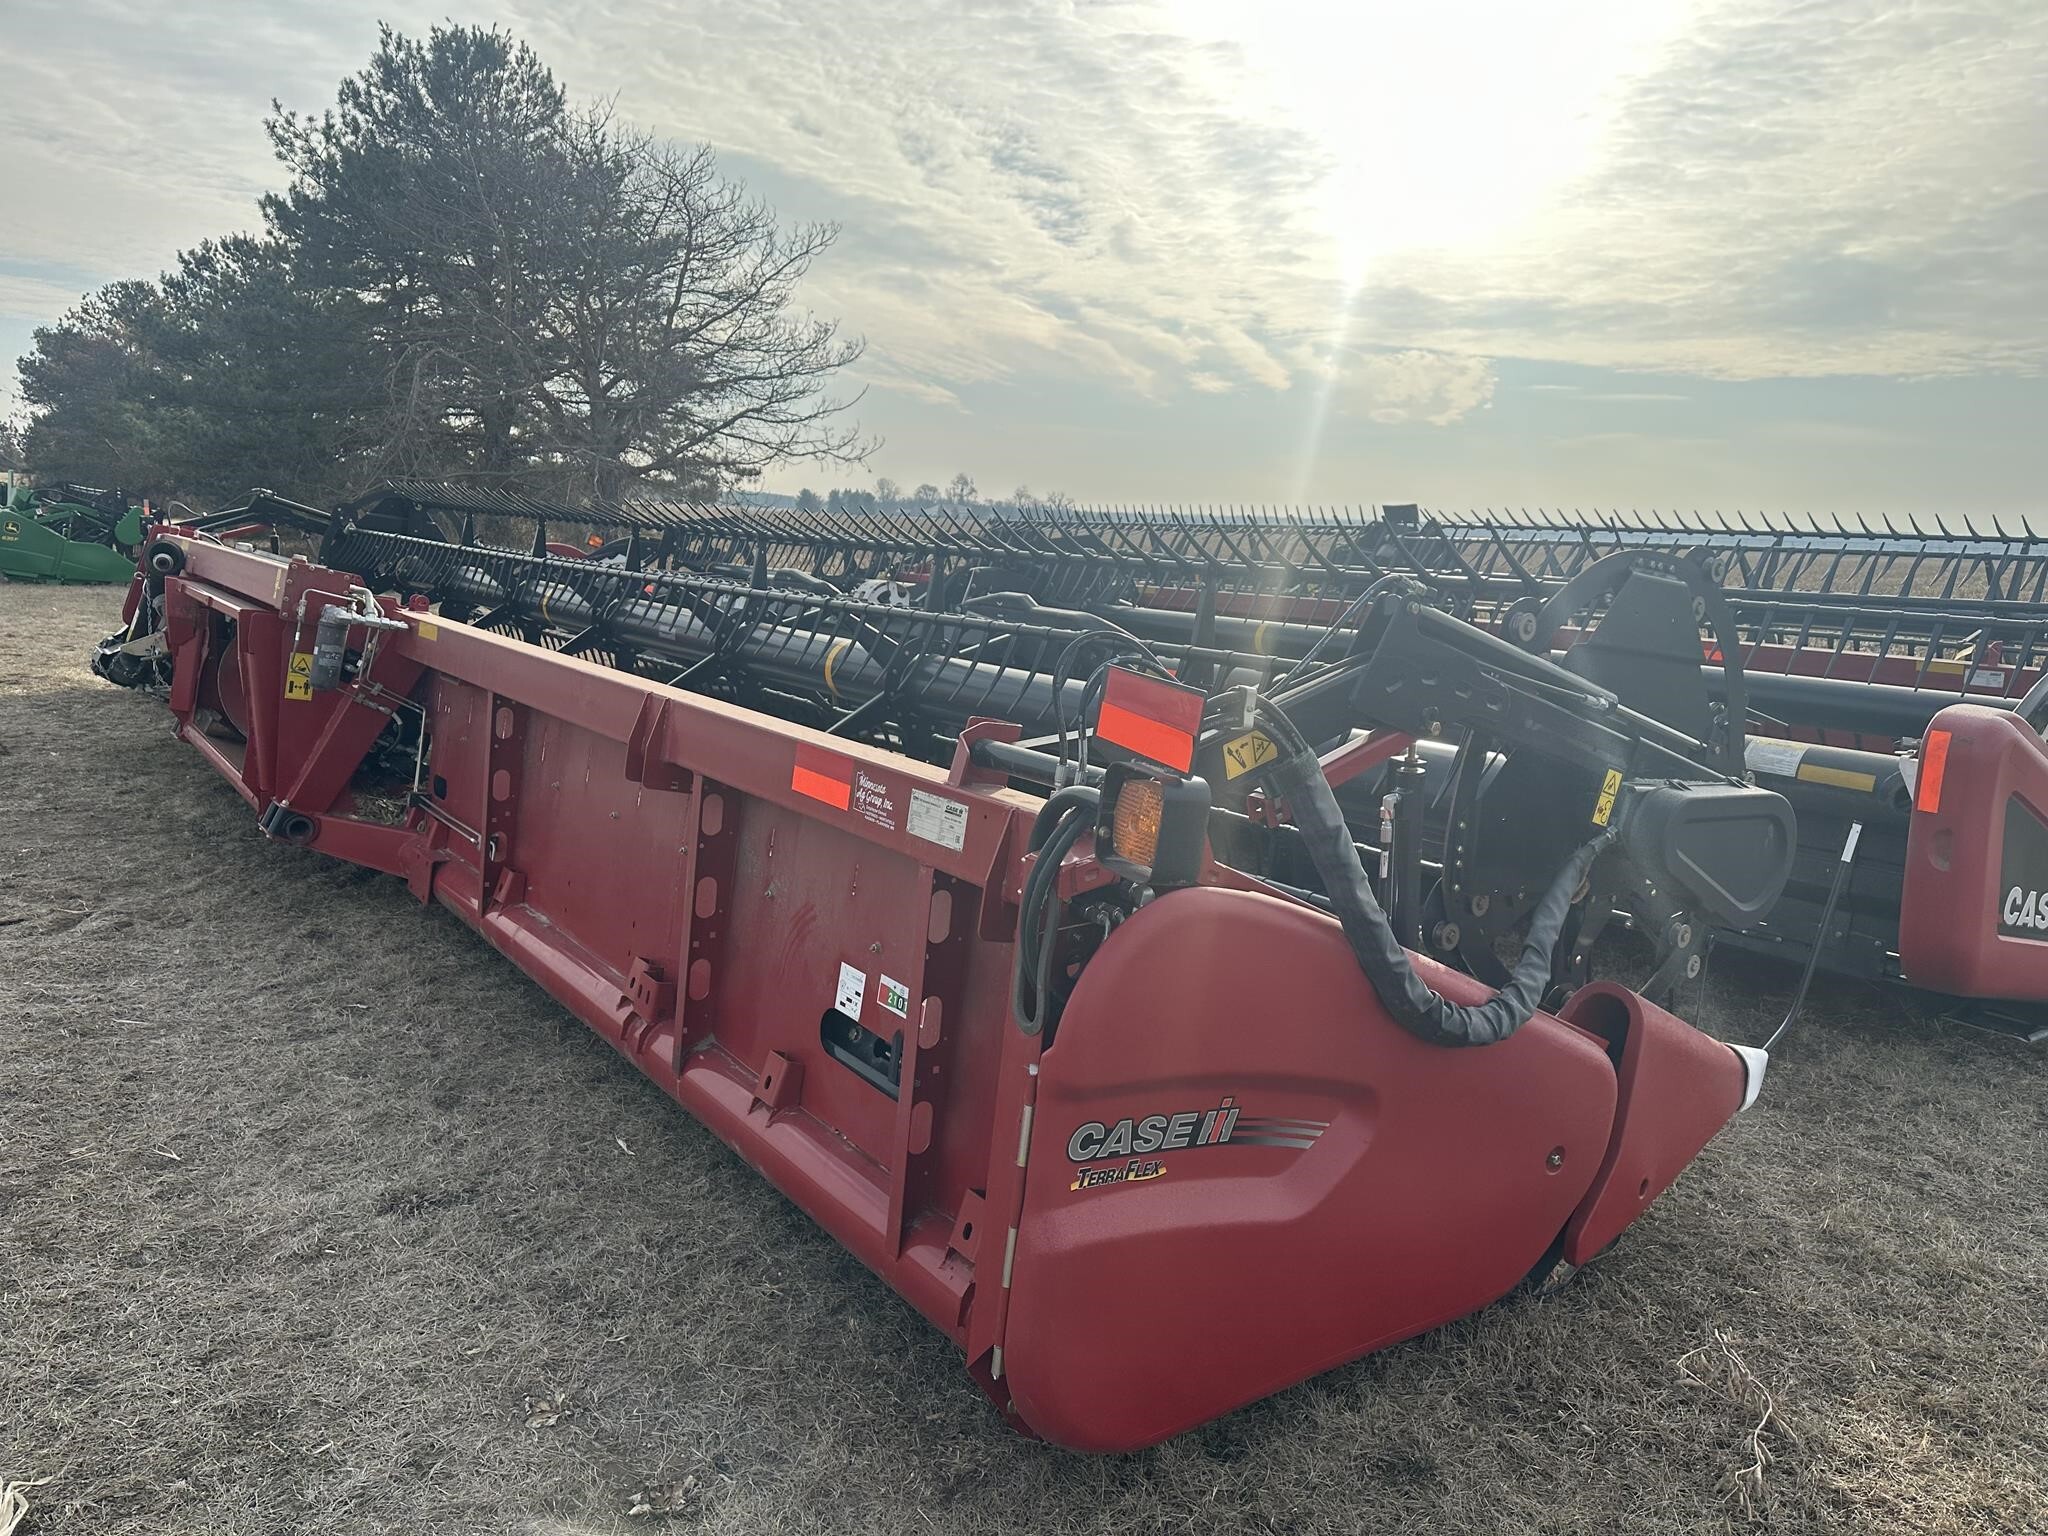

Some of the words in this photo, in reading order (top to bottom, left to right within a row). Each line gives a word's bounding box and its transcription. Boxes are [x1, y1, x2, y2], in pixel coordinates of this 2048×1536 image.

[859, 775, 886, 795] Minnesota
[856, 788, 866, 803] Ag
[1068, 1112, 1199, 1161] CASE
